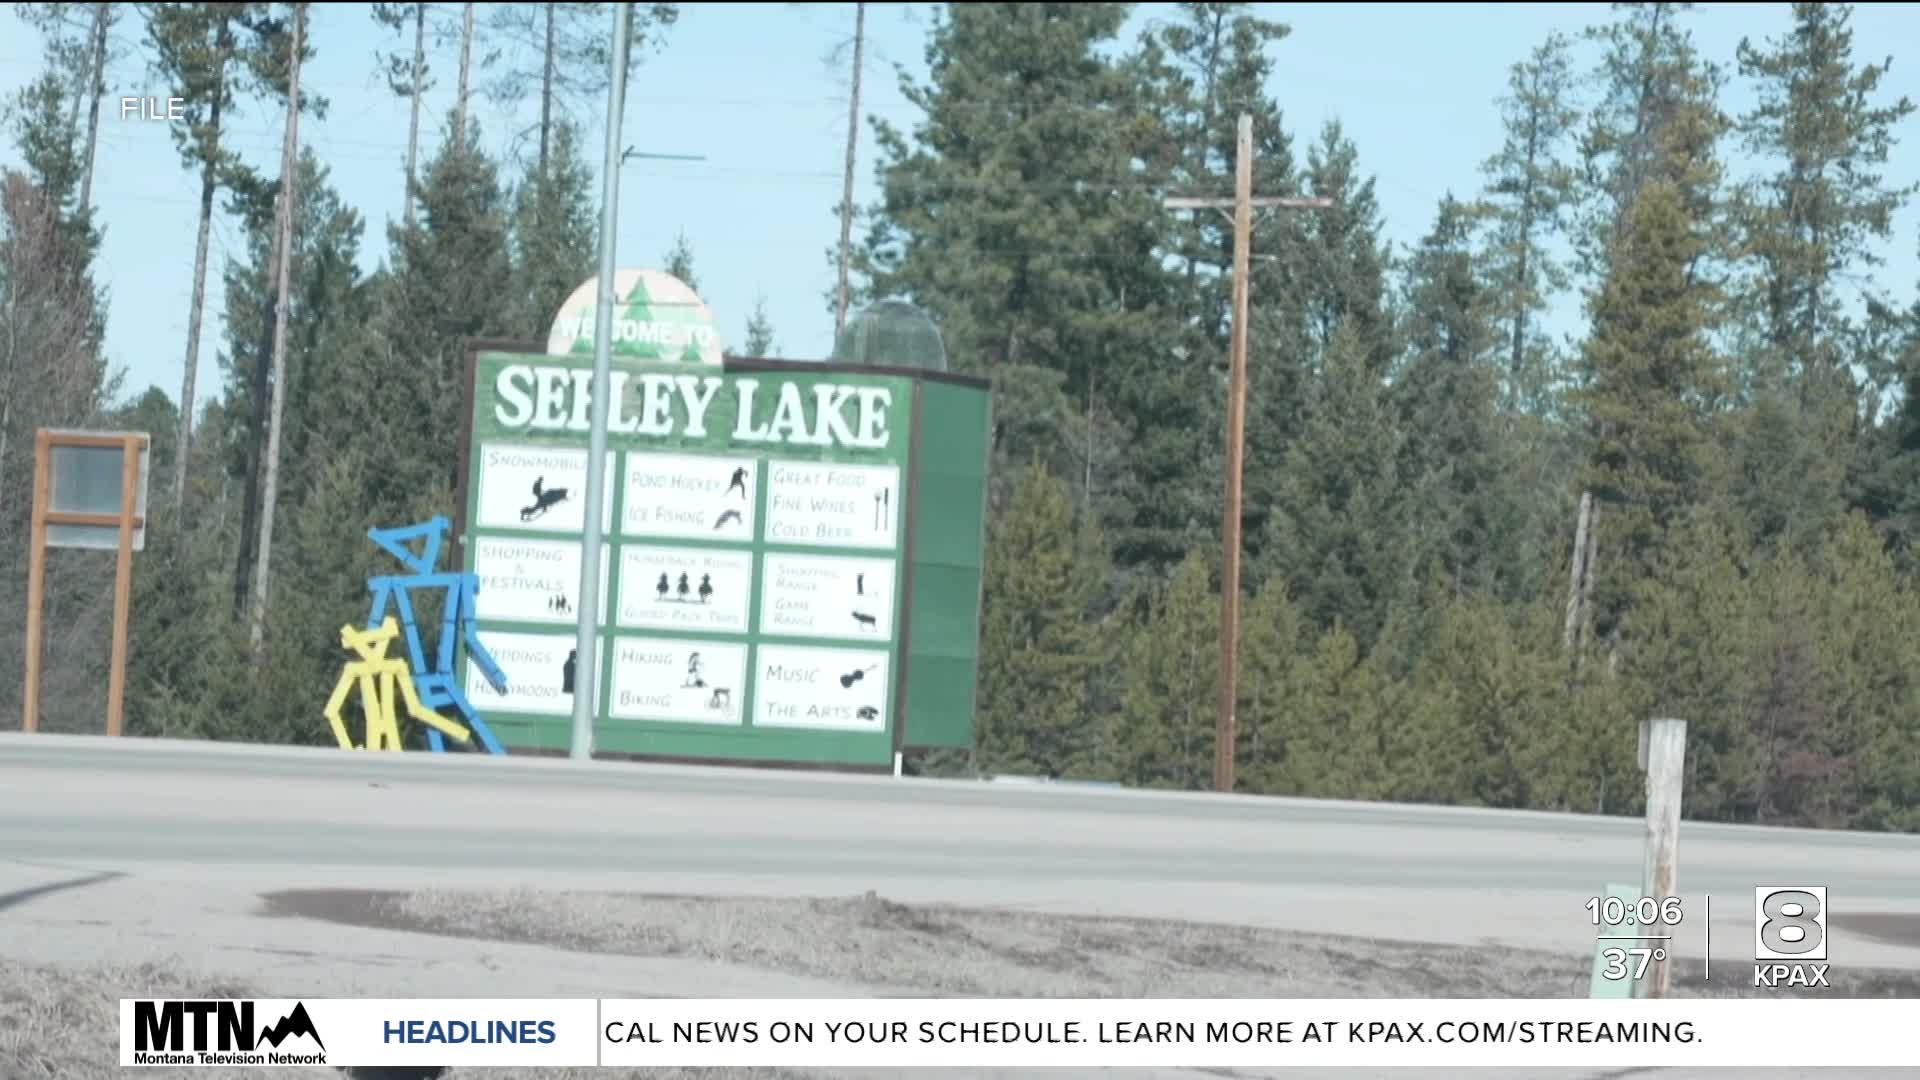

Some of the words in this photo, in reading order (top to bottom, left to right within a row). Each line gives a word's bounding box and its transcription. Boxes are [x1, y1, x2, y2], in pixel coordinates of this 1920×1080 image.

[682, 323, 713, 347] TO
[495, 364, 723, 438] SEELEY
[732, 379, 892, 449] LAKE
[774, 466, 821, 486] GREAT
[826, 470, 867, 489] FOOD
[481, 545, 564, 563] SHOPPING
[481, 575, 566, 593] FESTIVALS
[621, 648, 673, 665] HIKING
[766, 664, 821, 683] MUSIC
[619, 689, 671, 708] BIKING
[765, 699, 801, 718] THE
[805, 703, 853, 719] ARTS
